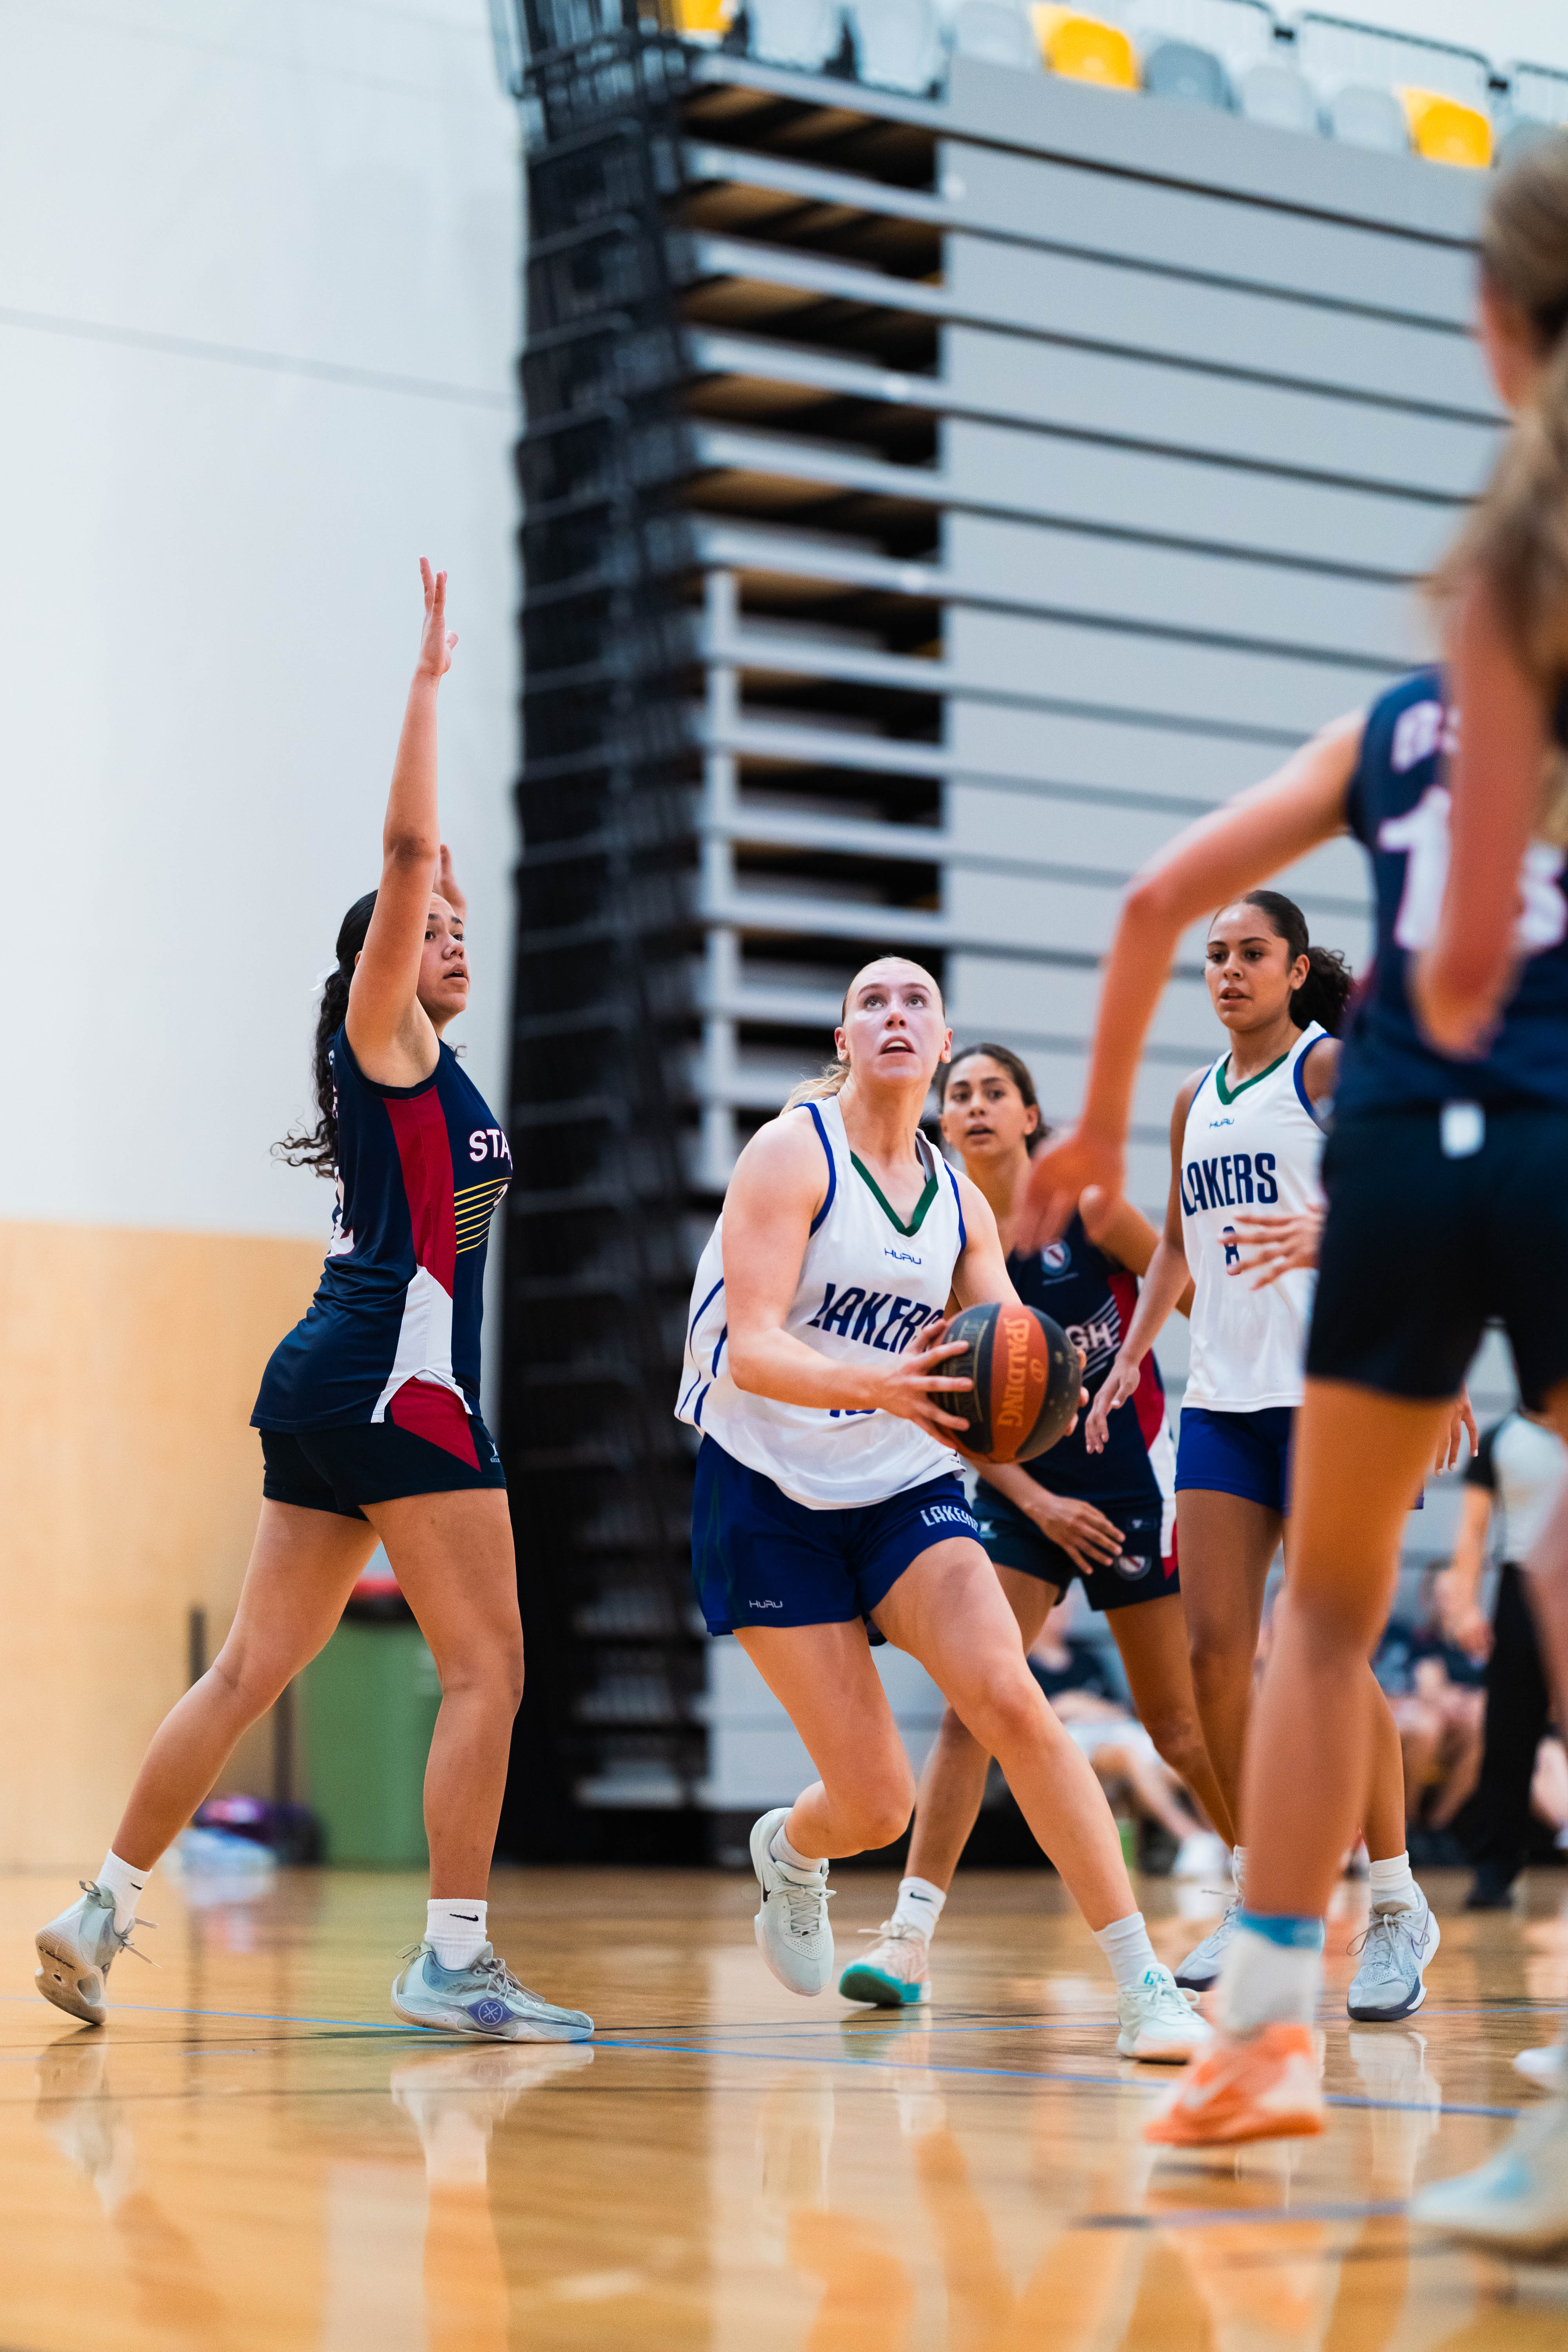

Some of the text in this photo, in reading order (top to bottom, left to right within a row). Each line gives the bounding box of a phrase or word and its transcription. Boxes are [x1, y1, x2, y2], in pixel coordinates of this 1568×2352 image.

[1209, 1118, 1235, 1129] HURU
[468, 1129, 513, 1171] STA
[1181, 1152, 1278, 1216] LAKERS
[884, 1248, 922, 1265] HURU
[1064, 1323, 1113, 1351] GH
[996, 1318, 1031, 1427] SPALDING
[749, 1600, 783, 1608] HURU
